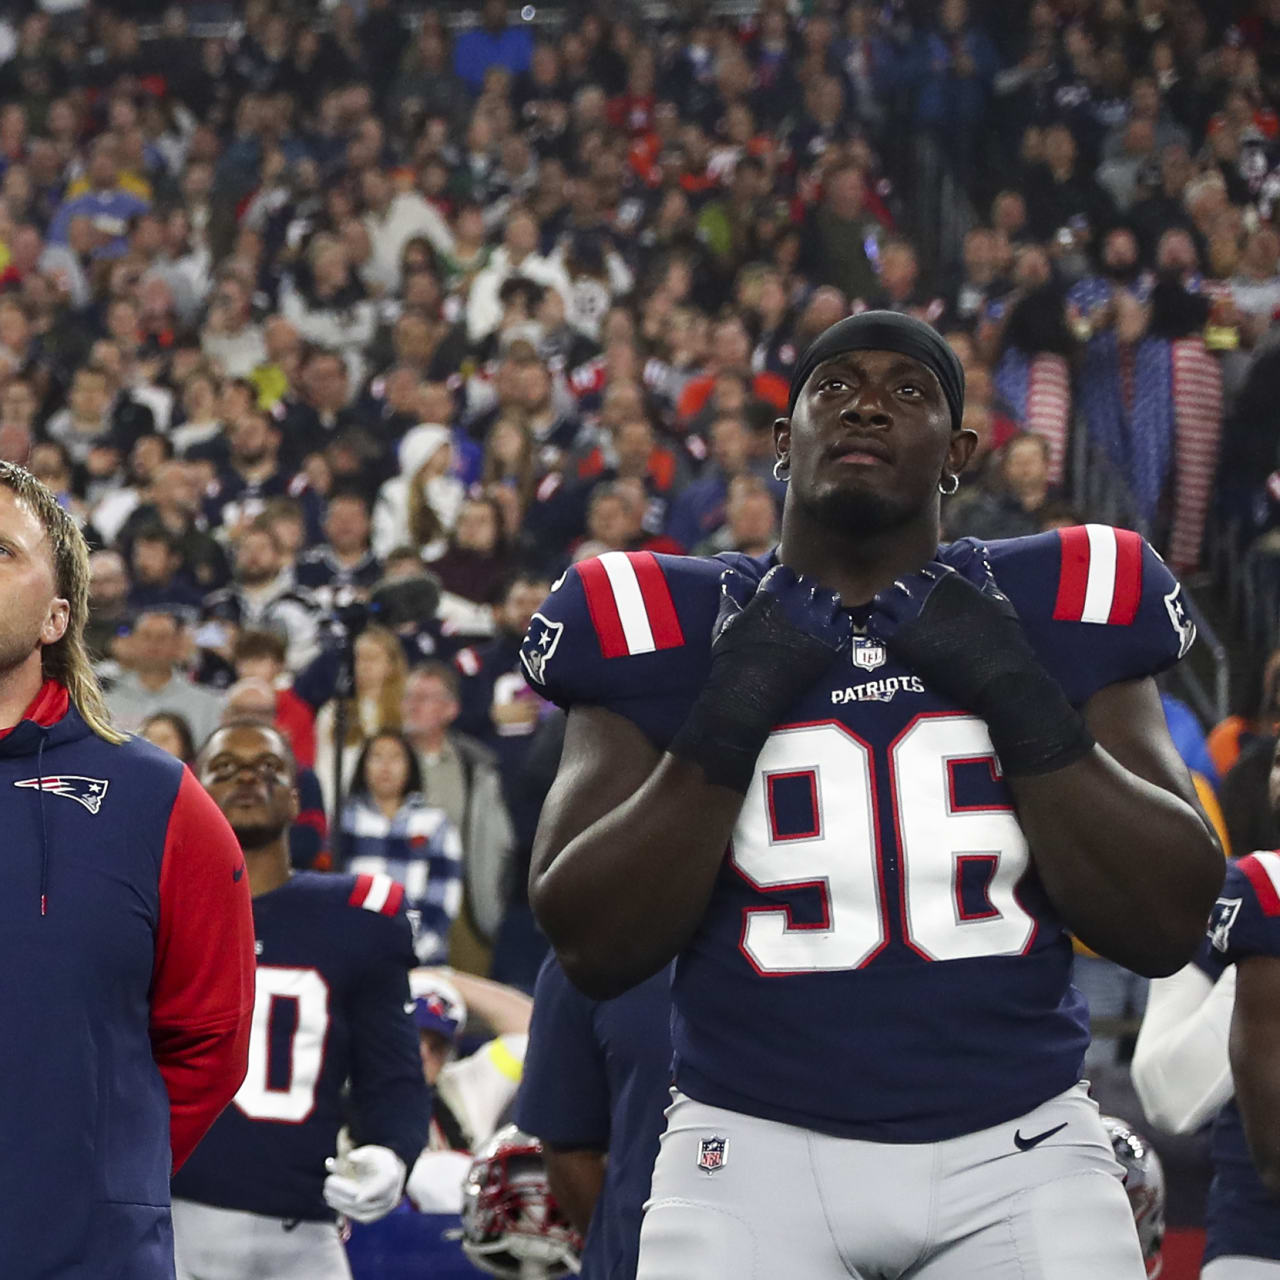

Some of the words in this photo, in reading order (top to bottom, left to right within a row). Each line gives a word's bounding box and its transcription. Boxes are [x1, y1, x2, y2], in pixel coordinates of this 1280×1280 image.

[831, 676, 925, 704] PATRIOTS
[728, 710, 1039, 977] 96
[231, 964, 329, 1124] 0
